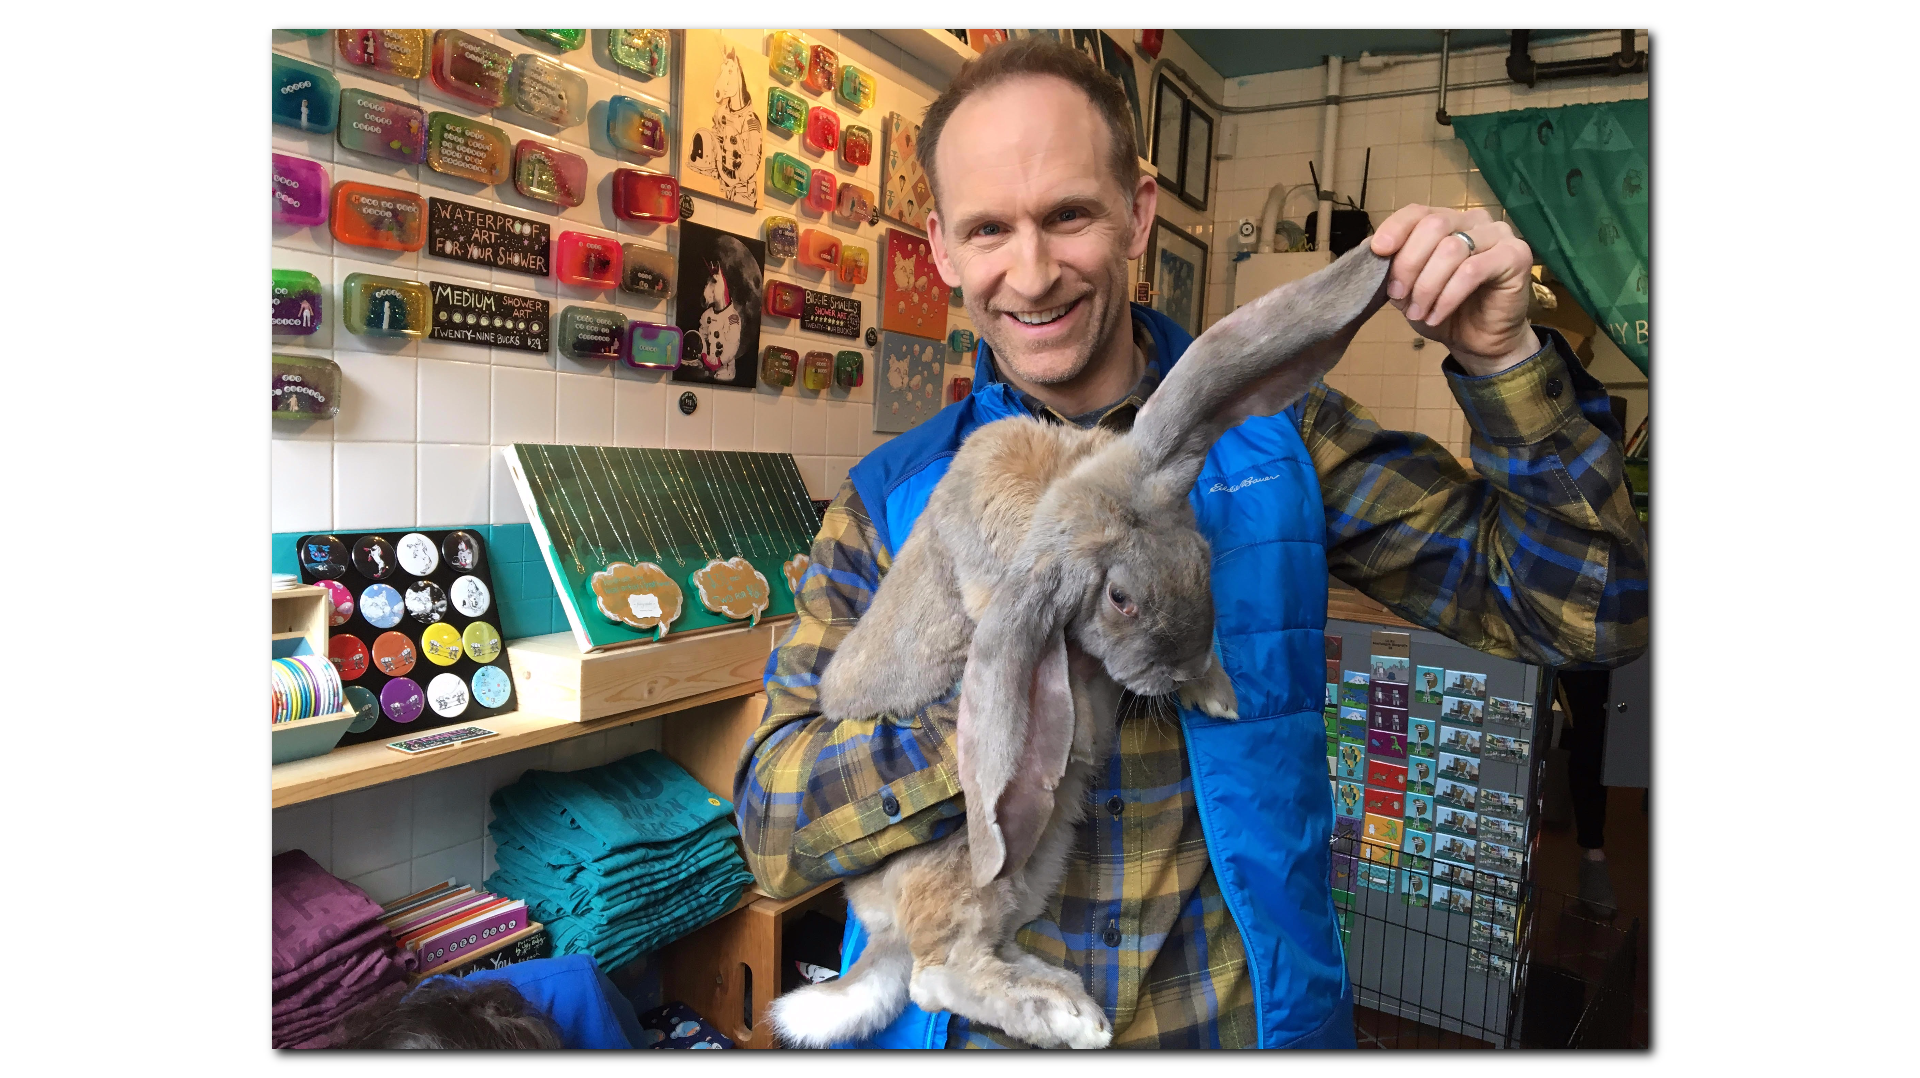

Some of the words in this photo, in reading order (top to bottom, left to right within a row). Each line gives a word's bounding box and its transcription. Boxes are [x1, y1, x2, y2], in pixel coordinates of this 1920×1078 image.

[437, 202, 540, 238] WATERPROOF
[471, 228, 500, 245] ART
[436, 237, 461, 256] FOR
[466, 242, 493, 262] YOUR
[497, 247, 547, 273] SHOWER
[434, 286, 496, 312] MEDIUM
[502, 295, 542, 312] SHOWER
[805, 291, 828, 306] BIGGIE
[830, 296, 858, 314] SMALLS
[512, 309, 533, 319] ART
[814, 306, 836, 317] SHOWER
[433, 326, 496, 343] TWENTY-NINE
[497, 333, 520, 346] BUCKS
[282, 374, 302, 383] SAD
[1207, 482, 1240, 495] Eddie
[1240, 474, 1280, 488] Bauer
[427, 948, 444, 962] GO
[449, 934, 477, 952] GET
[482, 920, 516, 939] YOUR
